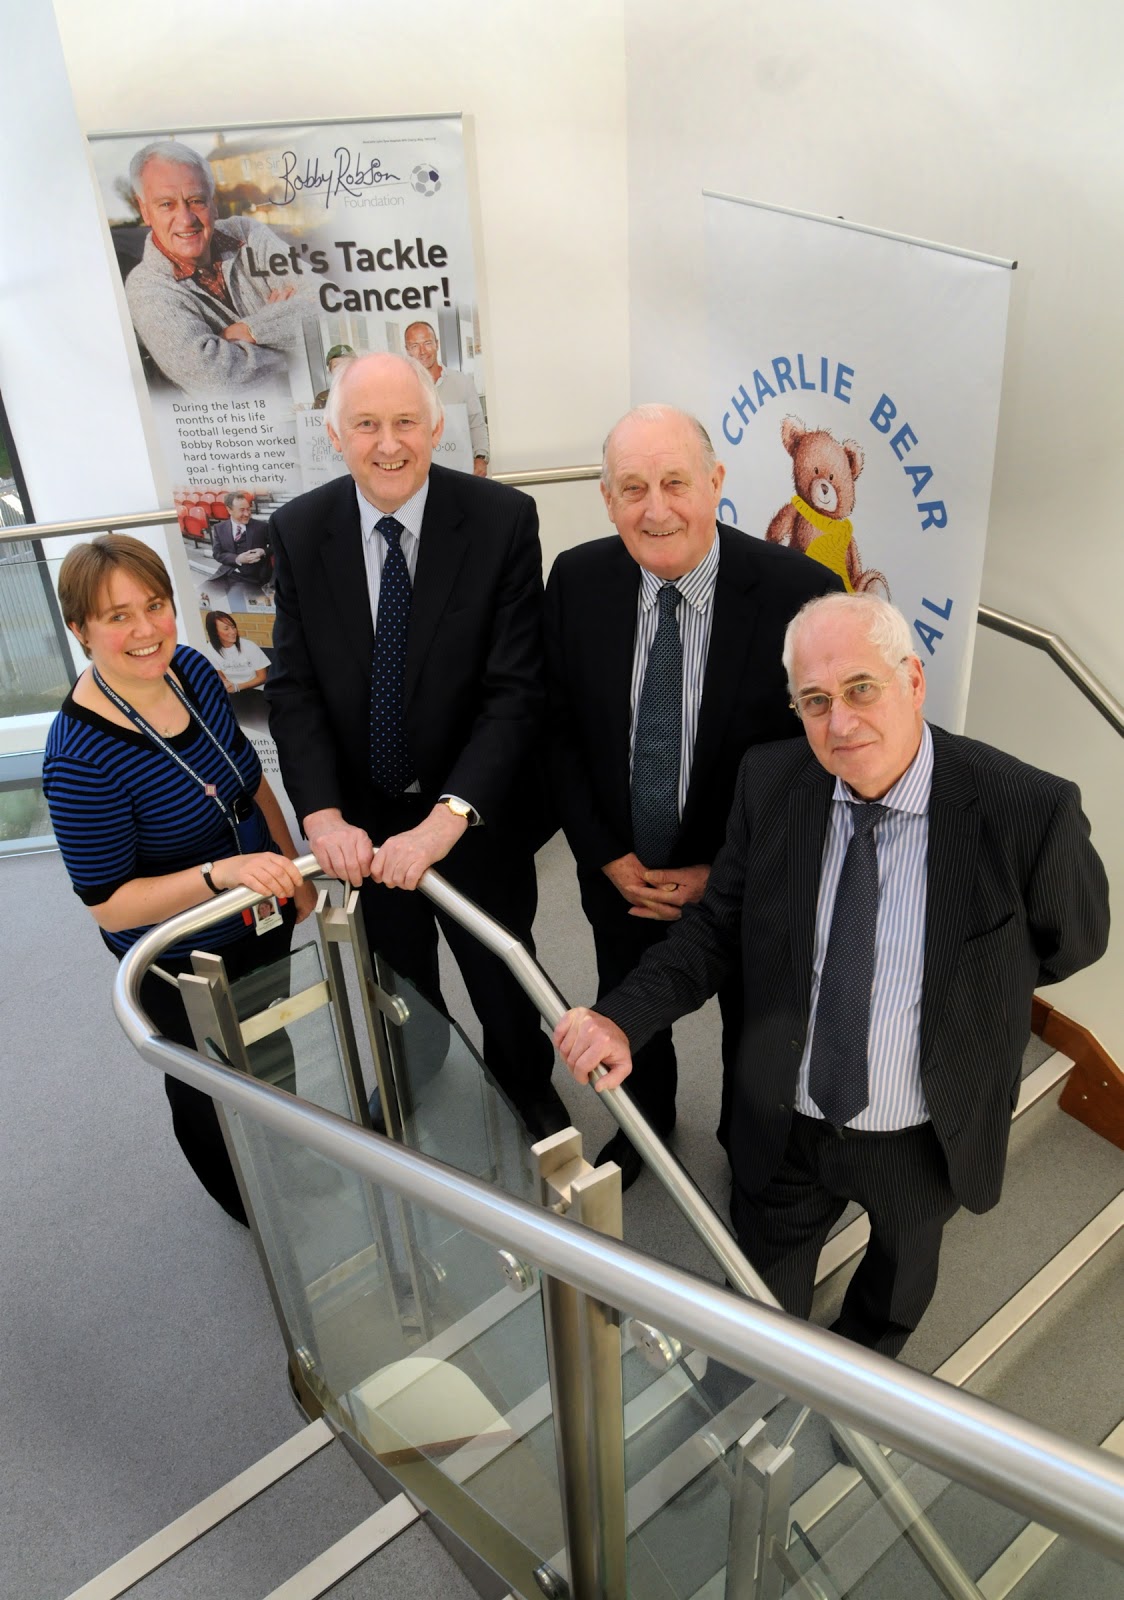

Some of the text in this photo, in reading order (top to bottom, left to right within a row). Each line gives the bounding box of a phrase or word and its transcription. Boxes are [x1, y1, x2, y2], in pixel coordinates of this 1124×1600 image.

[269, 151, 333, 209] Bobby
[344, 196, 404, 208] Foundation
[246, 238, 448, 278] Let's Tackle
[320, 277, 451, 313] Cancer!
[722, 354, 855, 445] CHARLIE
[173, 400, 265, 413] During the last 18
[176, 412, 265, 424] months of his life
[178, 425, 274, 437] football legend Sir
[181, 440, 212, 450] Bobby
[257, 436, 296, 446] worked
[184, 453, 206, 461] hard
[210, 451, 251, 460] towards
[870, 393, 948, 532] BEAR
[186, 465, 208, 475] goal
[218, 463, 259, 473] fighting
[189, 474, 286, 486] through his charity.
[134, 716, 146, 728] TRUST
[144, 726, 166, 748] FOUNDATION
[171, 753, 190, 771] HOSPITALS
